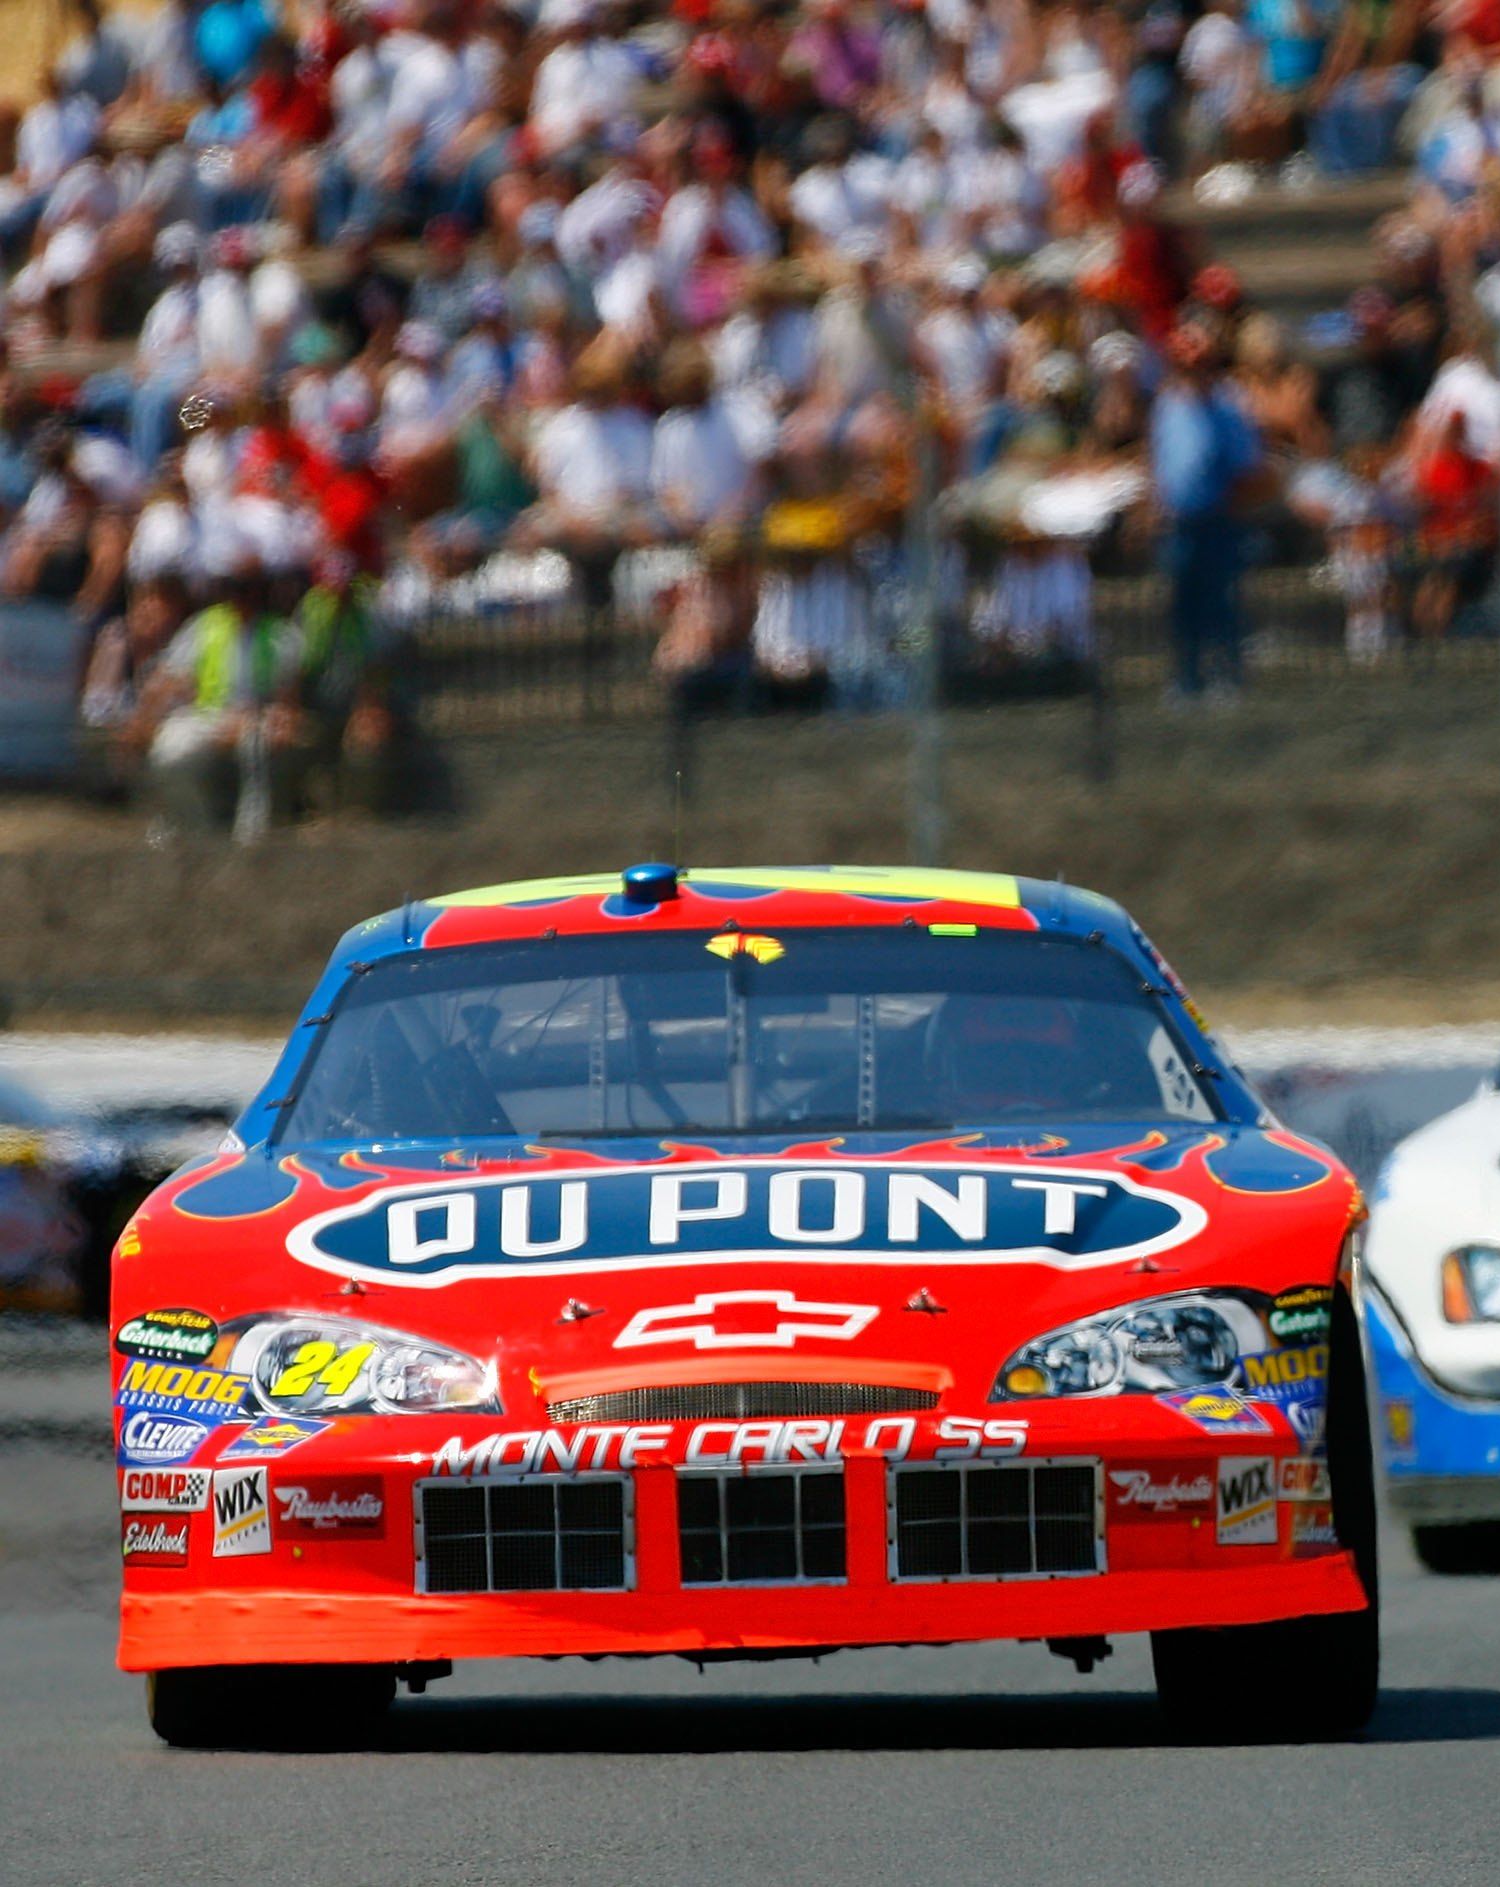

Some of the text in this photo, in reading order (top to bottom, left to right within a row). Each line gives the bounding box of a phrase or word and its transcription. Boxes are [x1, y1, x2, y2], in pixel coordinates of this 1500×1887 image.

[648, 1170, 1109, 1246] PONT
[118, 1320, 217, 1355] Gatorback
[119, 1361, 252, 1405] MOOG
[270, 1341, 378, 1397] 24
[1243, 1346, 1330, 1387] MOO
[126, 1411, 204, 1450] CLEVITE
[431, 1416, 1031, 1477] MONTE CARLO SS
[127, 1473, 188, 1500] COMP
[214, 1470, 263, 1525] WIX
[1220, 1461, 1270, 1514] WIX
[123, 1521, 188, 1554] Edelbrock
